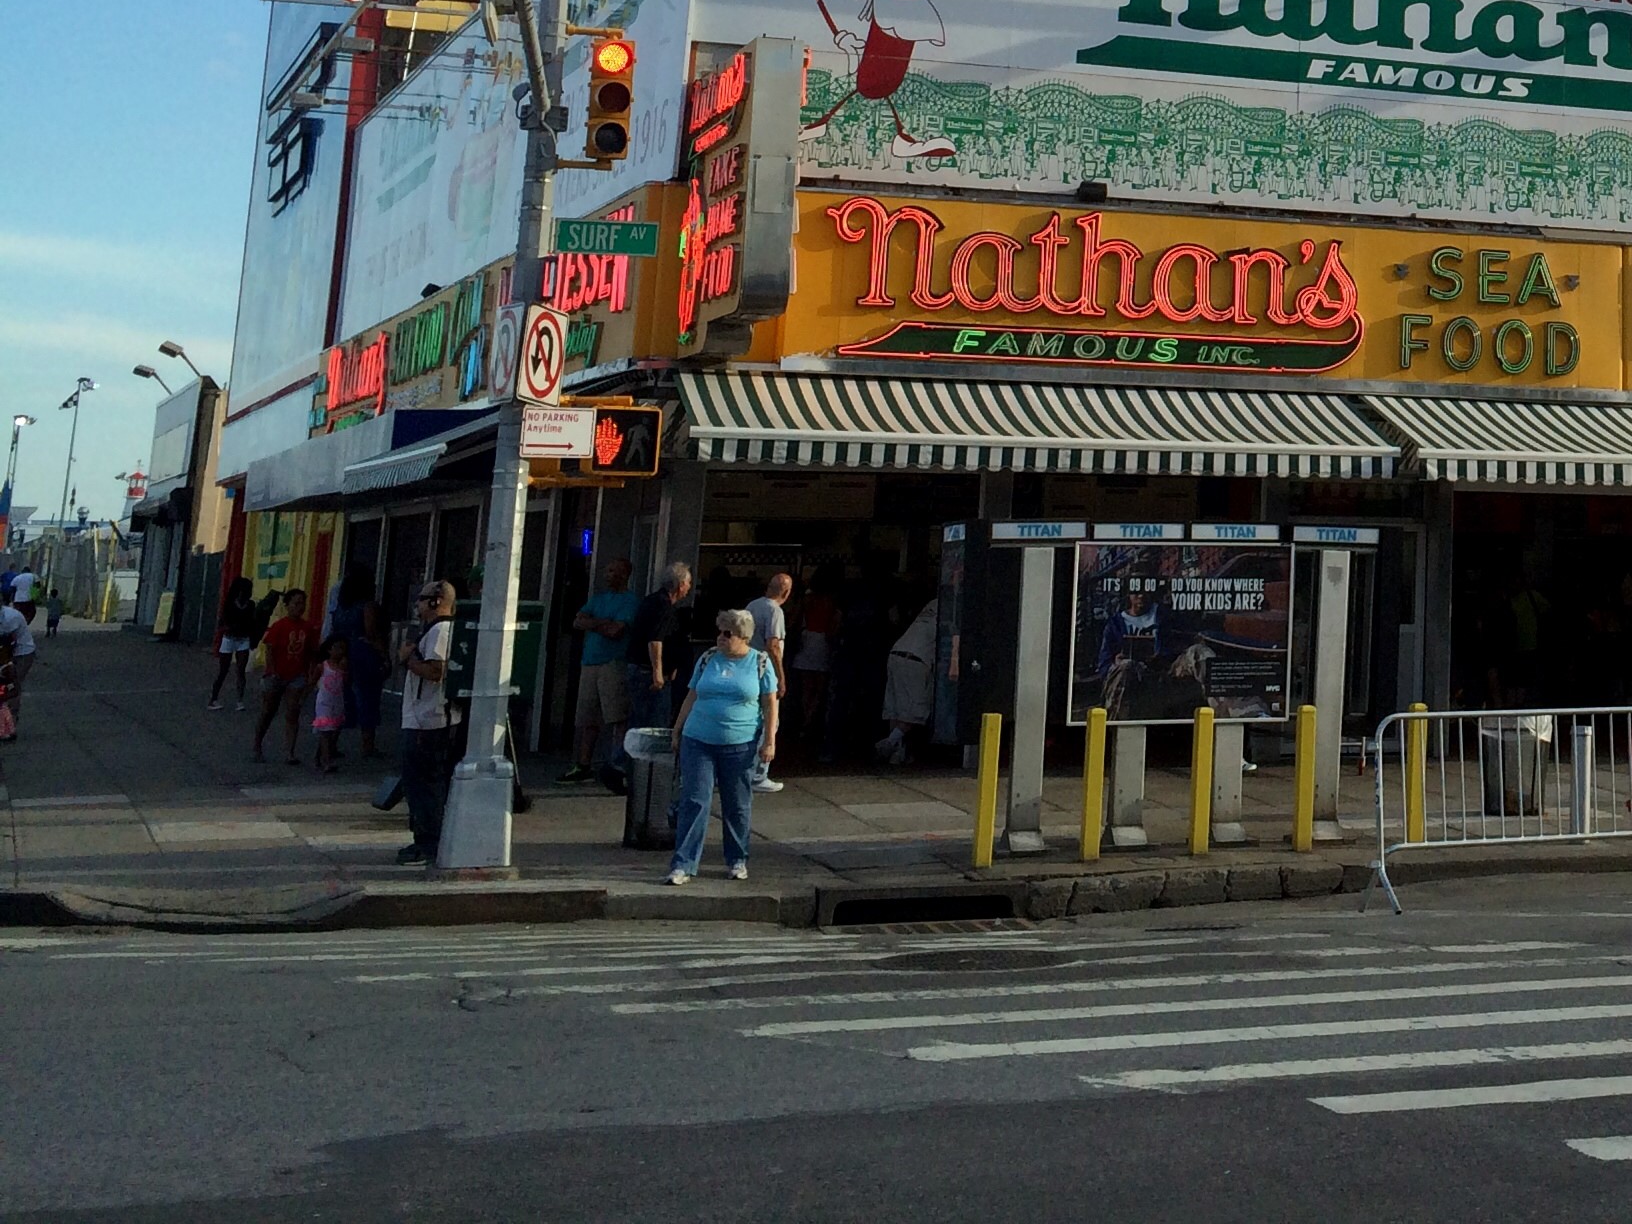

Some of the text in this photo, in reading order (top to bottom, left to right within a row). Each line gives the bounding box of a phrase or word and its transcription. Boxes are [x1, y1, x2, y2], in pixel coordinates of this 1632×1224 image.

[1305, 59, 1534, 99] FAMOUS
[567, 223, 647, 250] SURF AV
[826, 197, 1361, 328] Nathan's
[1426, 245, 1562, 310] SEA
[953, 329, 1179, 364] FAMOUS
[1399, 313, 1582, 377] FOOD
[527, 412, 580, 424] NO PARKING
[527, 423, 563, 434] Anytime
[1017, 524, 1063, 537] TITAN
[1119, 524, 1164, 538] TITAN
[1214, 526, 1257, 539] TITAN
[1316, 529, 1358, 542] TITAN
[1103, 577, 1121, 592] IT'S
[1129, 577, 1141, 592] 09
[1171, 577, 1184, 592] DO
[1185, 578, 1203, 592] YOU
[1204, 578, 1233, 592] KNOW
[1234, 578, 1265, 592] WHERE
[1171, 593, 1265, 611] YOUR KIDS ARE?
